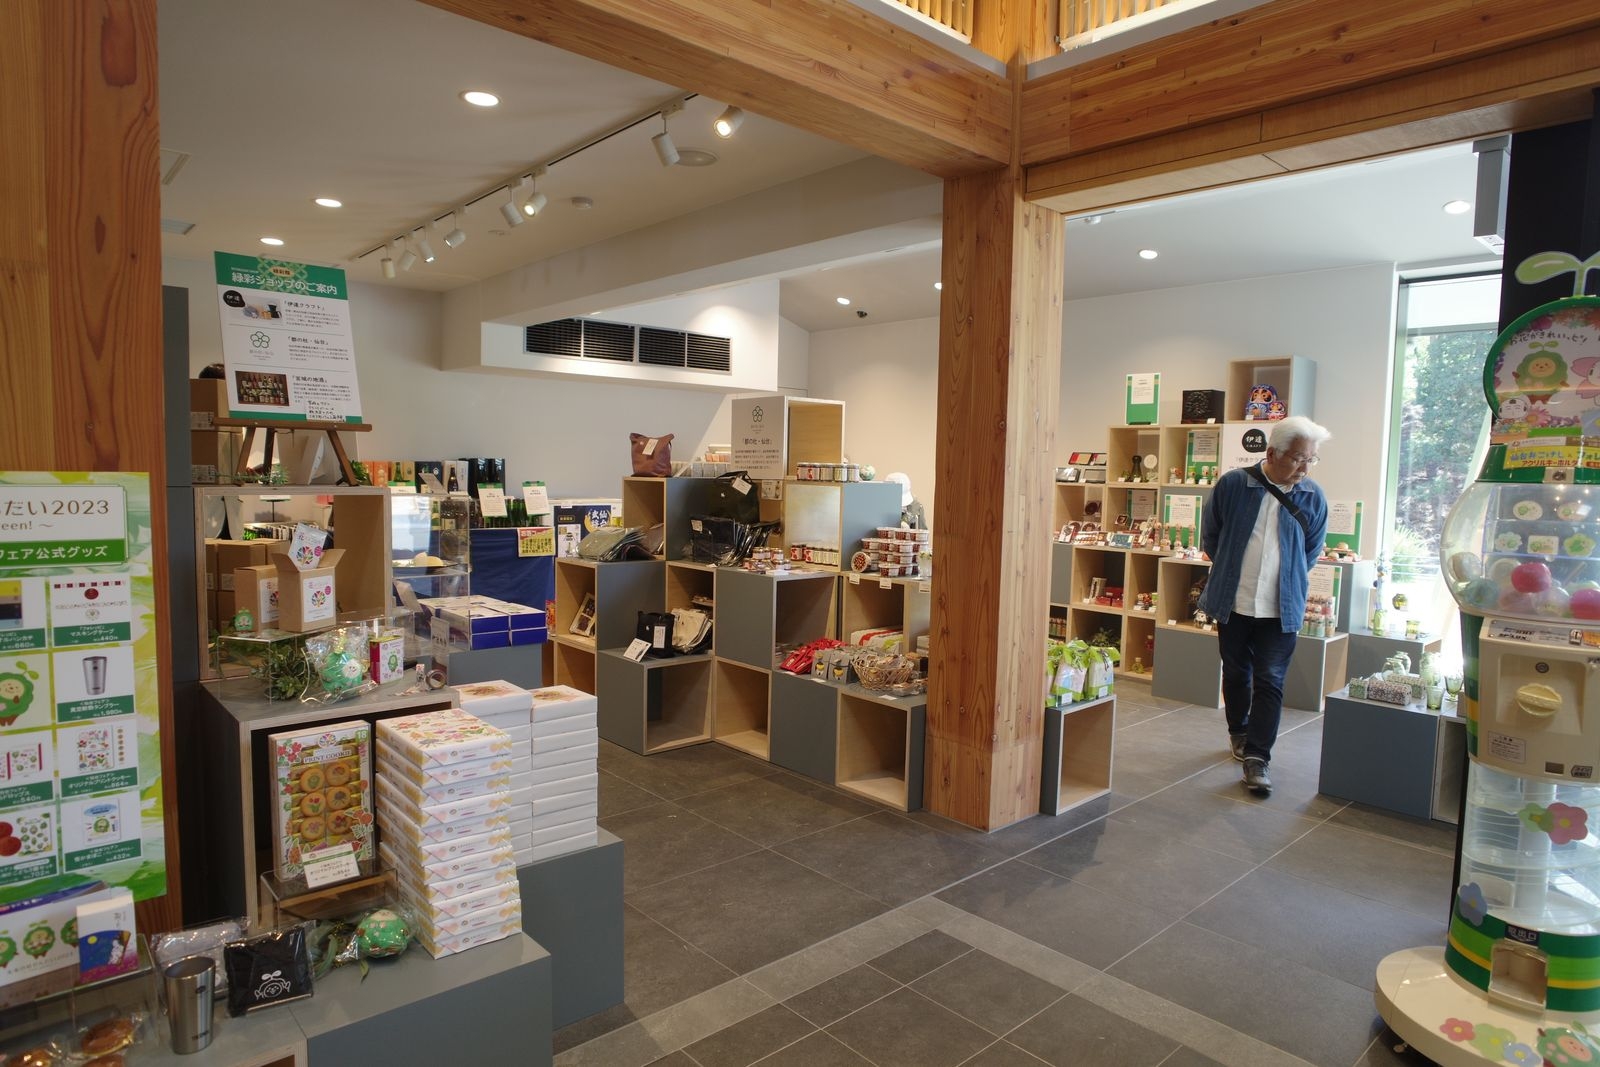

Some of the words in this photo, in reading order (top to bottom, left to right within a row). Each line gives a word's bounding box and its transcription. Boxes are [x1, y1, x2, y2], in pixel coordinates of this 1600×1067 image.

[231, 271, 338, 295] 緑彩ショップのご案内
[1245, 435, 1263, 444] 伊達
[0, 499, 110, 516] だい2023
[0, 520, 33, 531] een!
[357, 730, 367, 740] 18
[304, 754, 325, 764] PRINT
[326, 750, 351, 761] COOKIE
